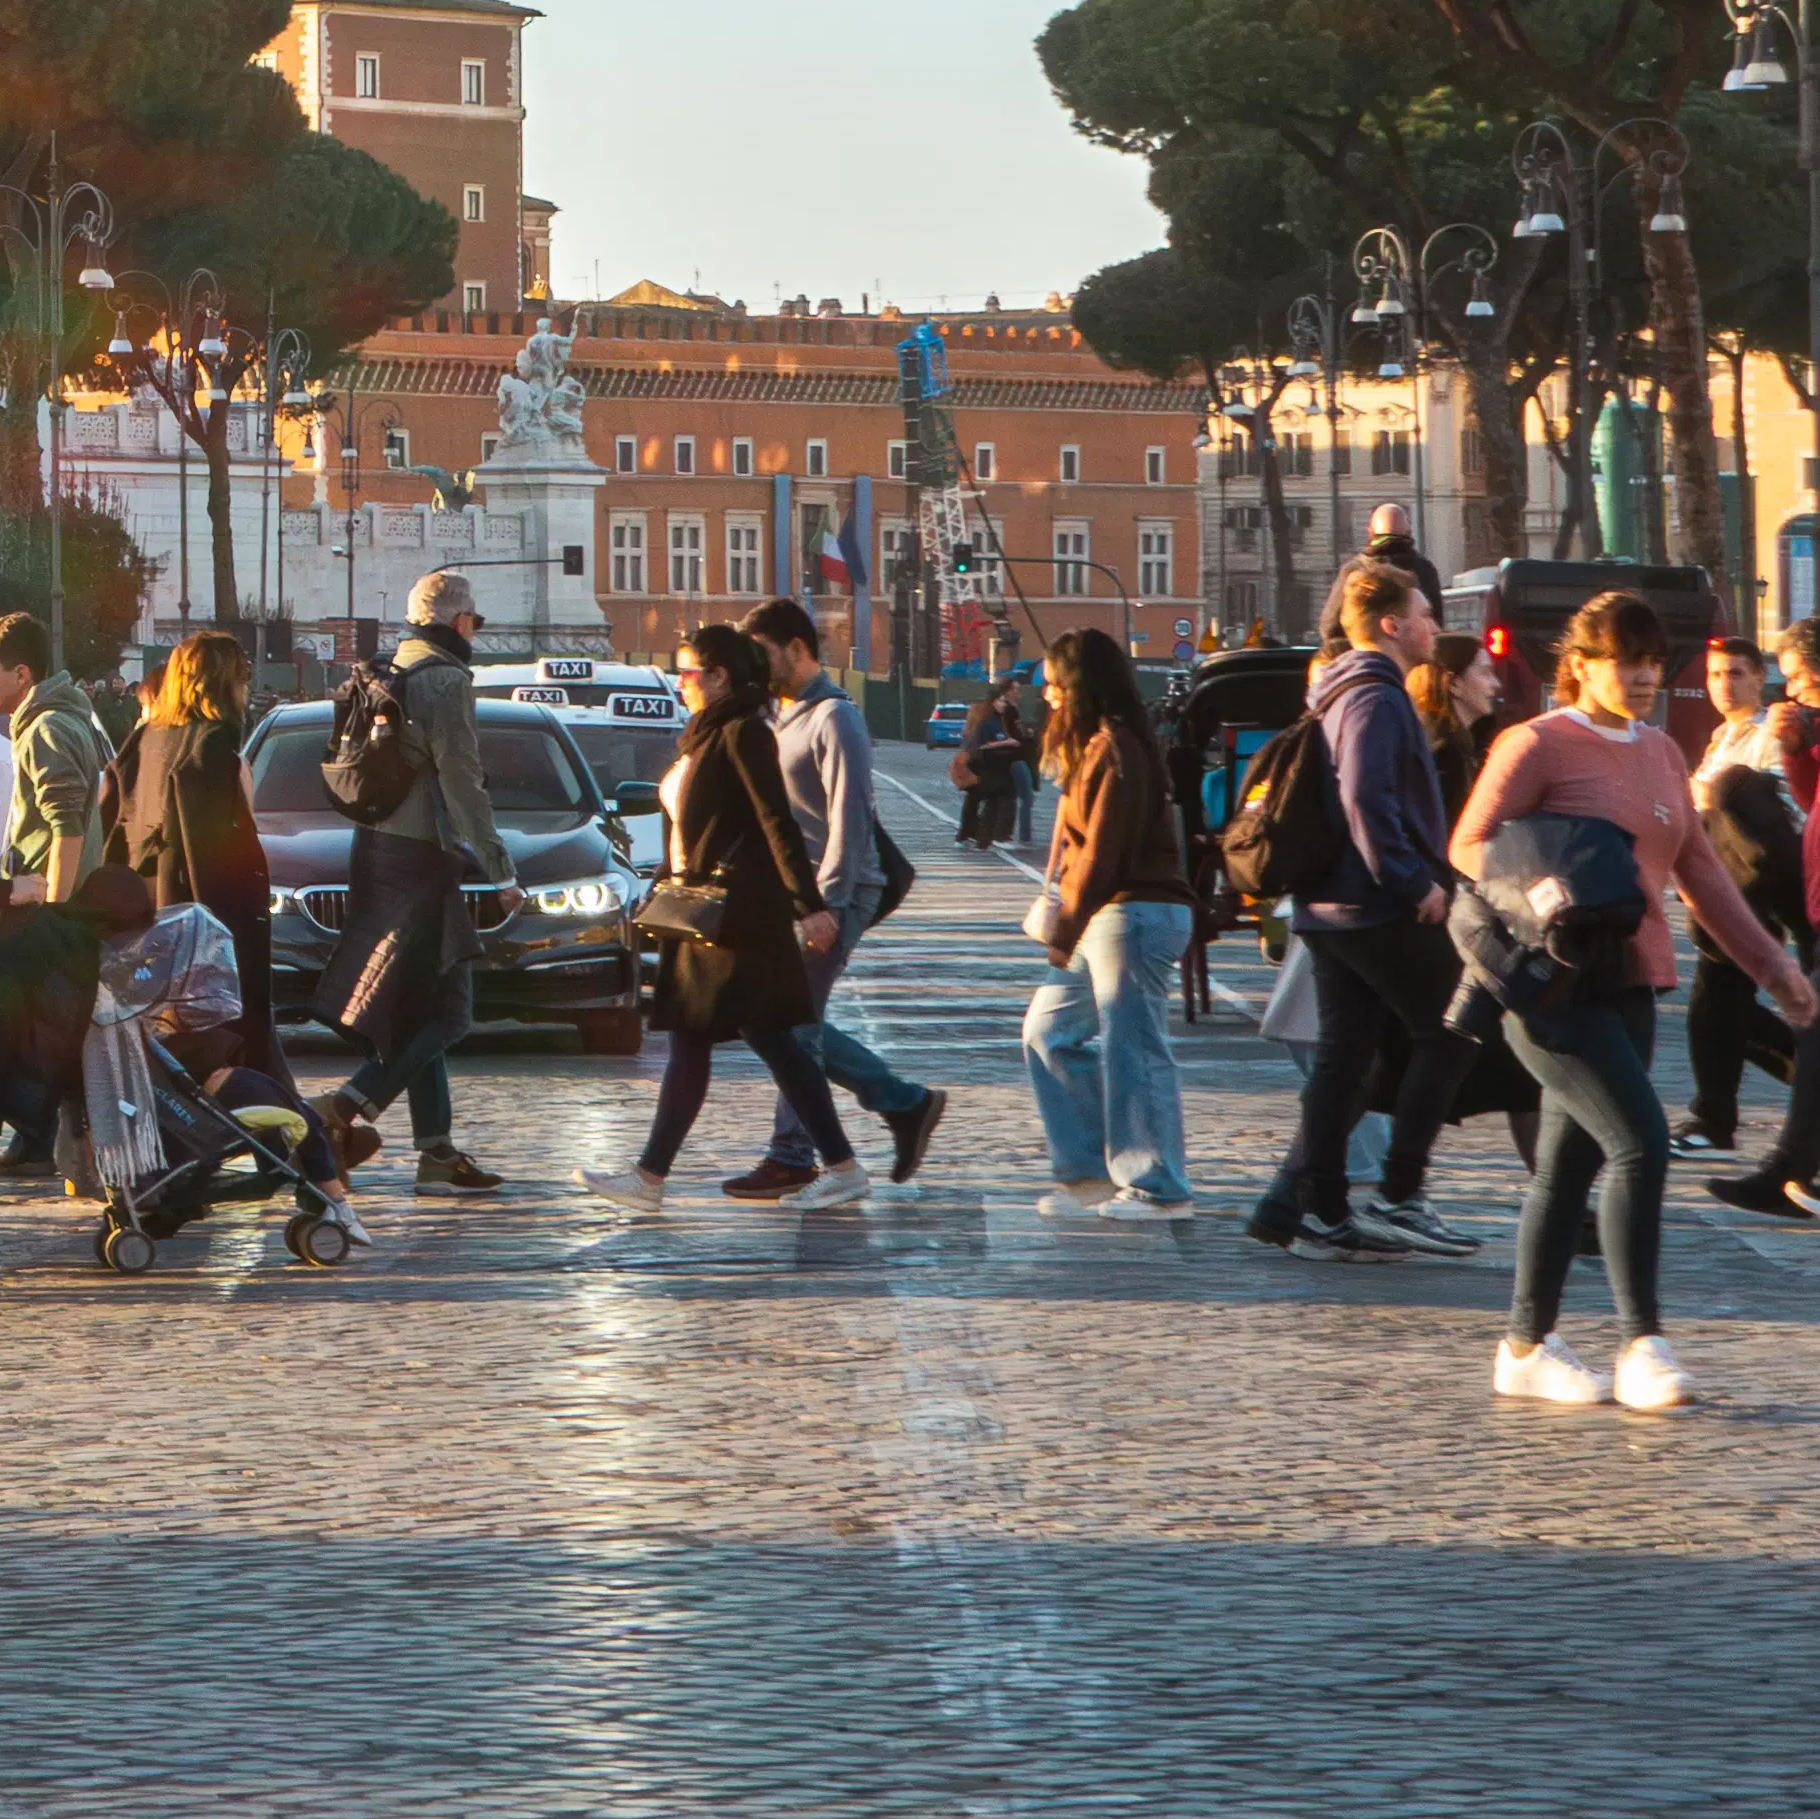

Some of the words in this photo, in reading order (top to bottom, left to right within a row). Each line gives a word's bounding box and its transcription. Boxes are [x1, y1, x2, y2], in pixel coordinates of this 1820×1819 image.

[550, 663, 587, 676] TAXI
[520, 691, 560, 702] TAXI
[621, 698, 666, 715] TAXI
